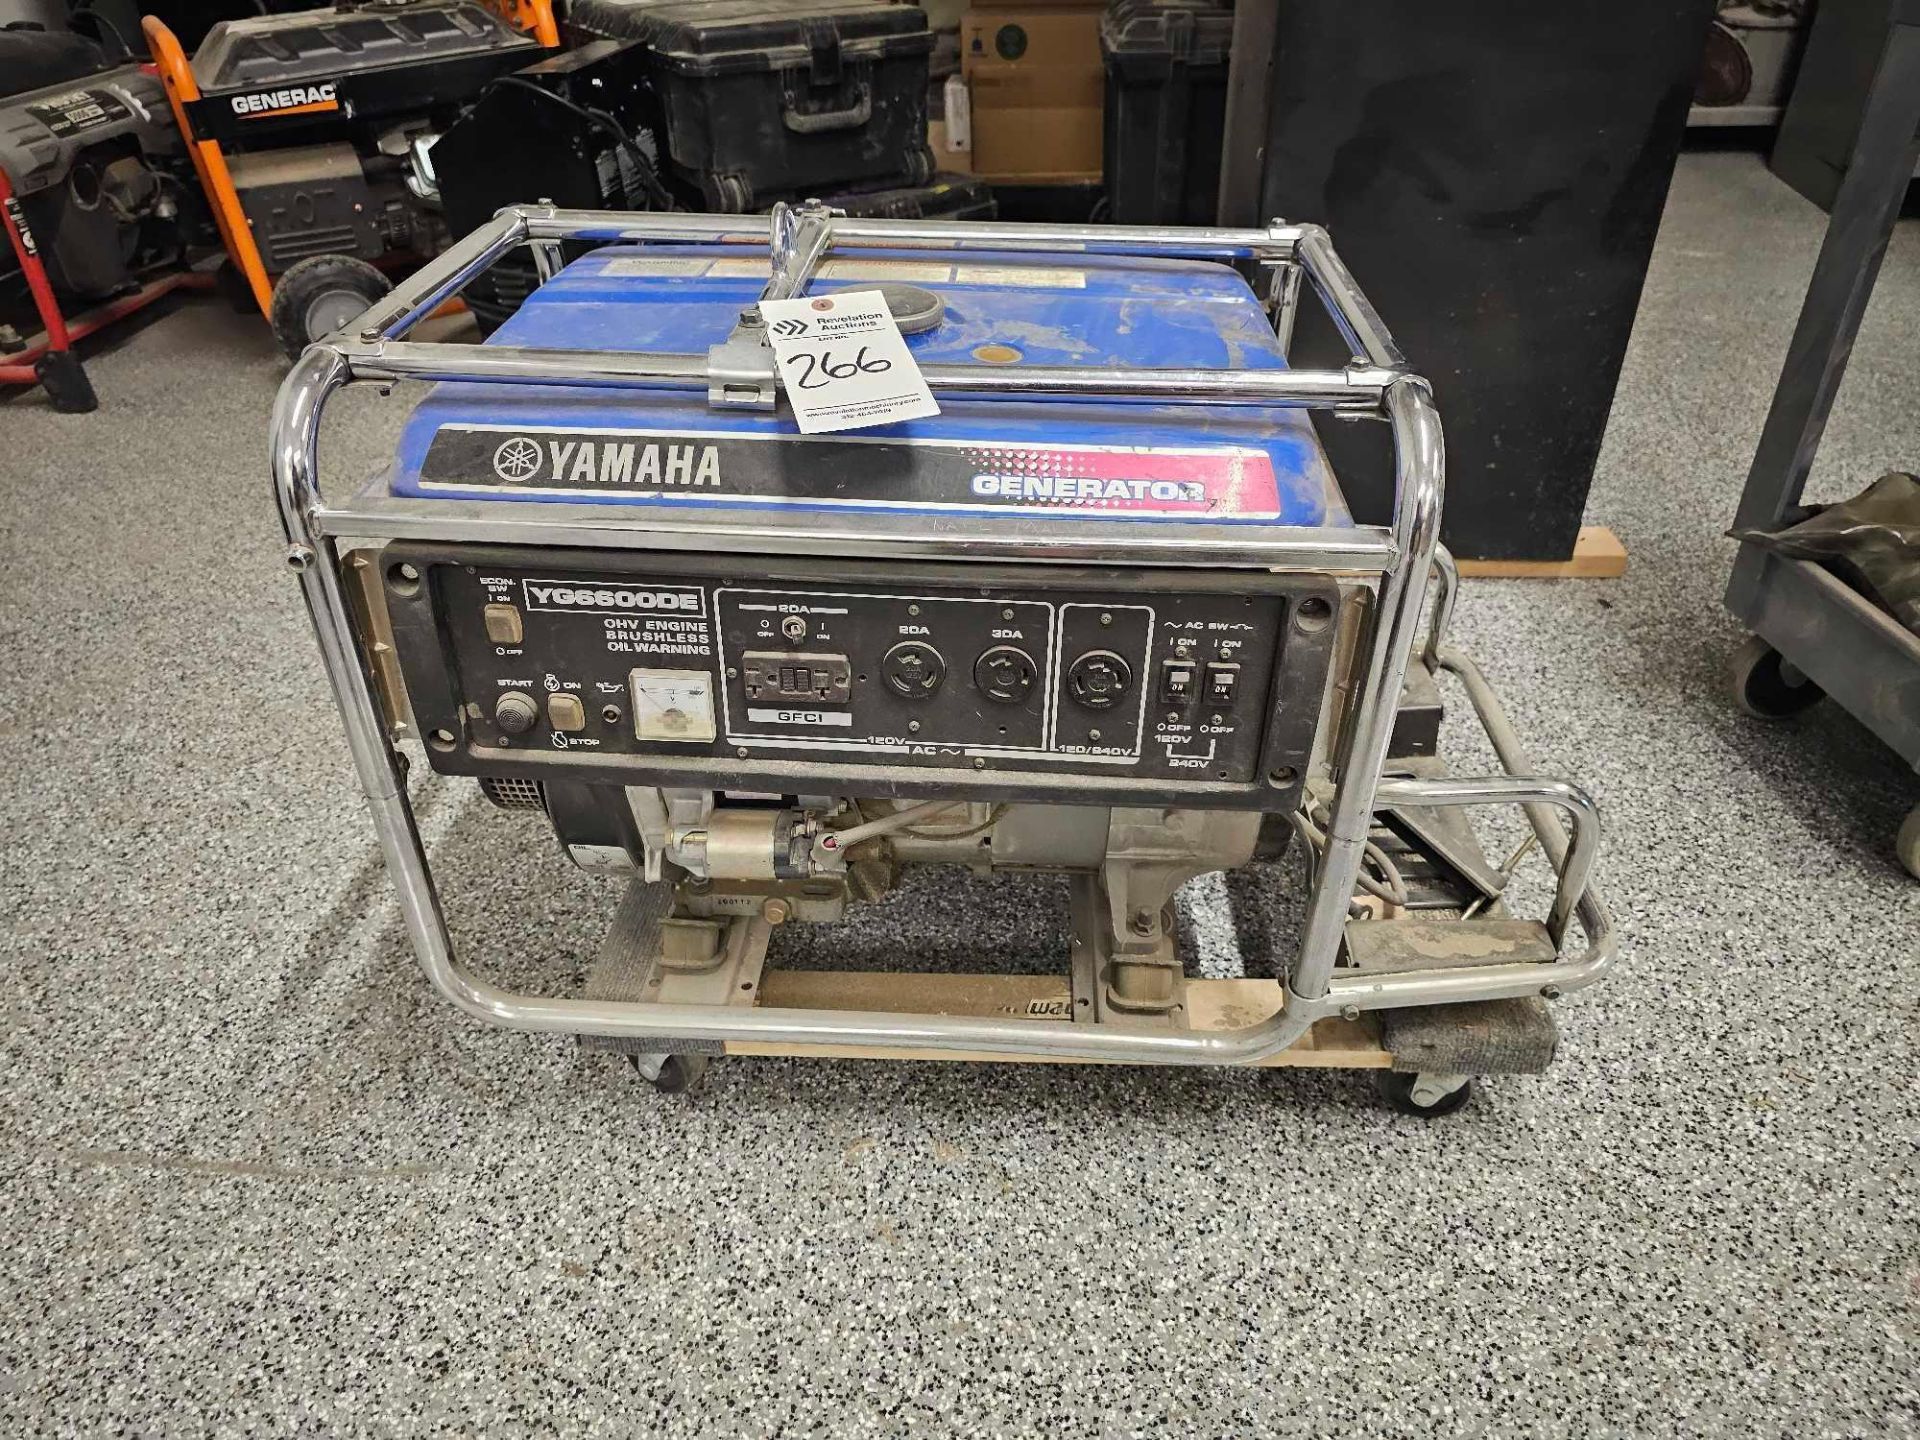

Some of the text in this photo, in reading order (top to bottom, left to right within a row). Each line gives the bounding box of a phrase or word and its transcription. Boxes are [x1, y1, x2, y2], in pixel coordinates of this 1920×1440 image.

[231, 84, 336, 114] GENERAC
[817, 313, 883, 324] Revelation
[822, 321, 877, 331] Auctions
[787, 346, 892, 389] 266
[549, 440, 721, 486] YAMAHA
[971, 472, 1205, 502] GENERATOR
[480, 577, 516, 586] ECON.
[529, 587, 699, 611] YG6600DE
[778, 604, 811, 614] 20A
[604, 618, 708, 632] OHV ENGINE
[899, 625, 931, 635] 20A
[1185, 621, 1204, 630] AC
[606, 631, 710, 644] BRUSHLESS
[991, 629, 1024, 640] 30A
[1178, 638, 1197, 646] ON
[1222, 640, 1242, 648] ON
[607, 642, 711, 656] OIL WARNING
[497, 679, 534, 688] START
[563, 681, 582, 689] ON
[778, 711, 824, 723] GFCI
[568, 738, 600, 746] STOP
[867, 735, 906, 746] 120V
[1154, 734, 1193, 744] 120V
[912, 745, 937, 756] AC
[1058, 744, 1133, 756] 120/240V
[1168, 758, 1210, 769] 240V
